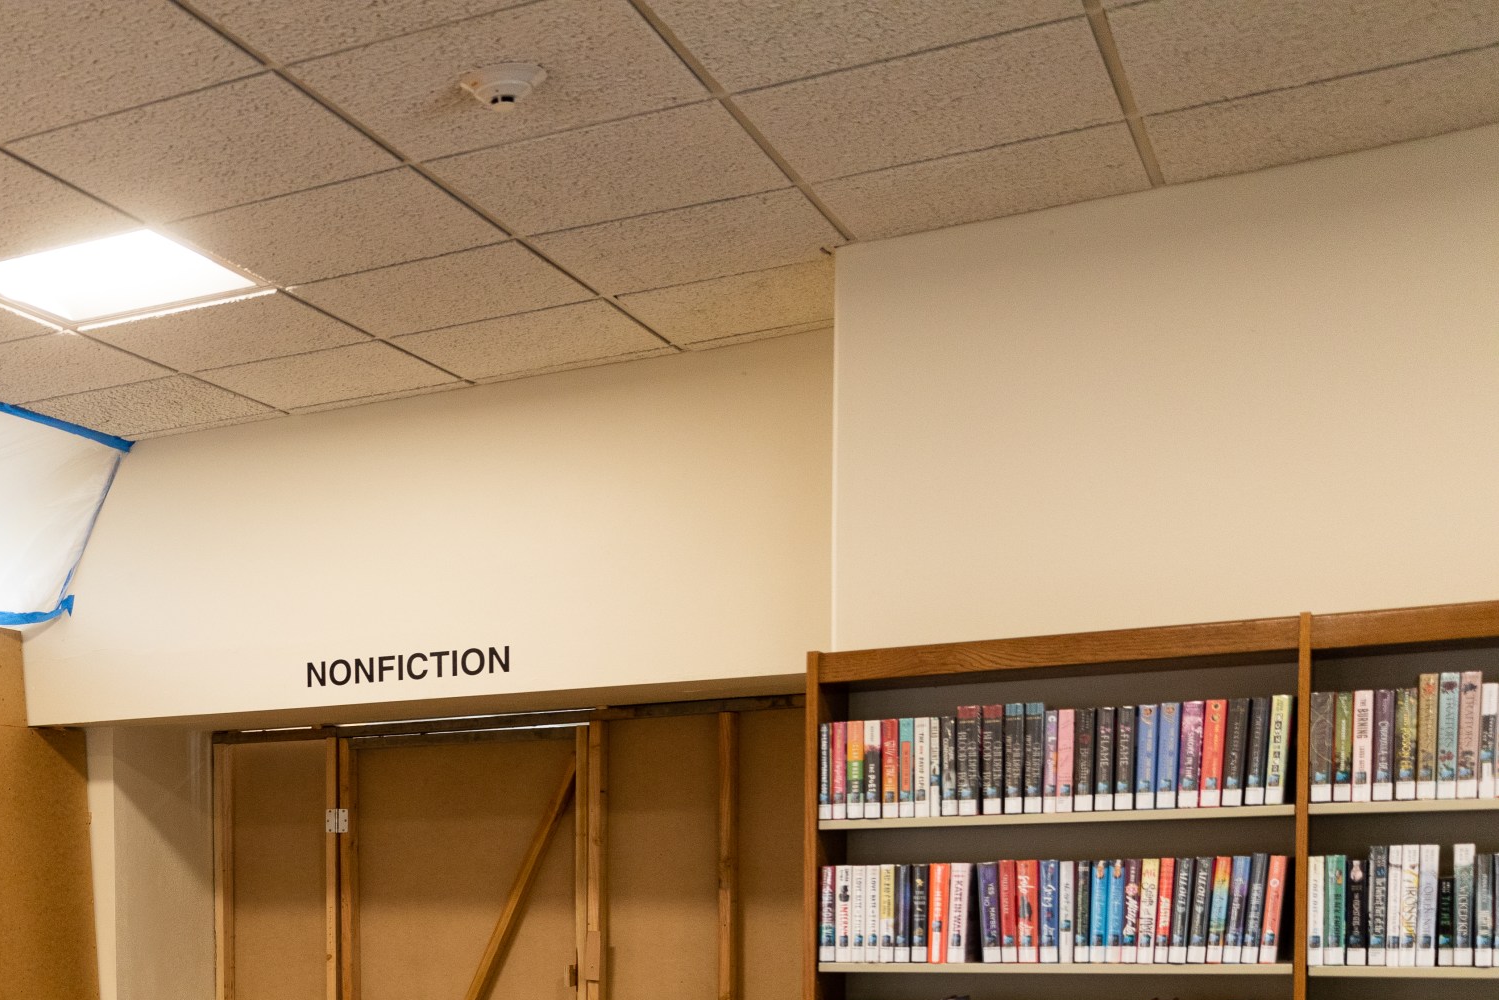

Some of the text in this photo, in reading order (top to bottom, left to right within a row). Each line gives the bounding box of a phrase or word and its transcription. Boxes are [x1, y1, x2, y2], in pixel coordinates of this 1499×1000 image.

[307, 645, 510, 687] NONFICTION
[1356, 708, 1369, 739] BURNING
[1099, 735, 1109, 767] FLAME
[1119, 734, 1130, 766] FLAME
[1186, 731, 1195, 755] SMOKE
[953, 880, 963, 902] KATE
[984, 896, 990, 907] NO
[988, 883, 996, 895] YES
[989, 907, 998, 929] MAYBE
[1440, 896, 1451, 926] TITHE
